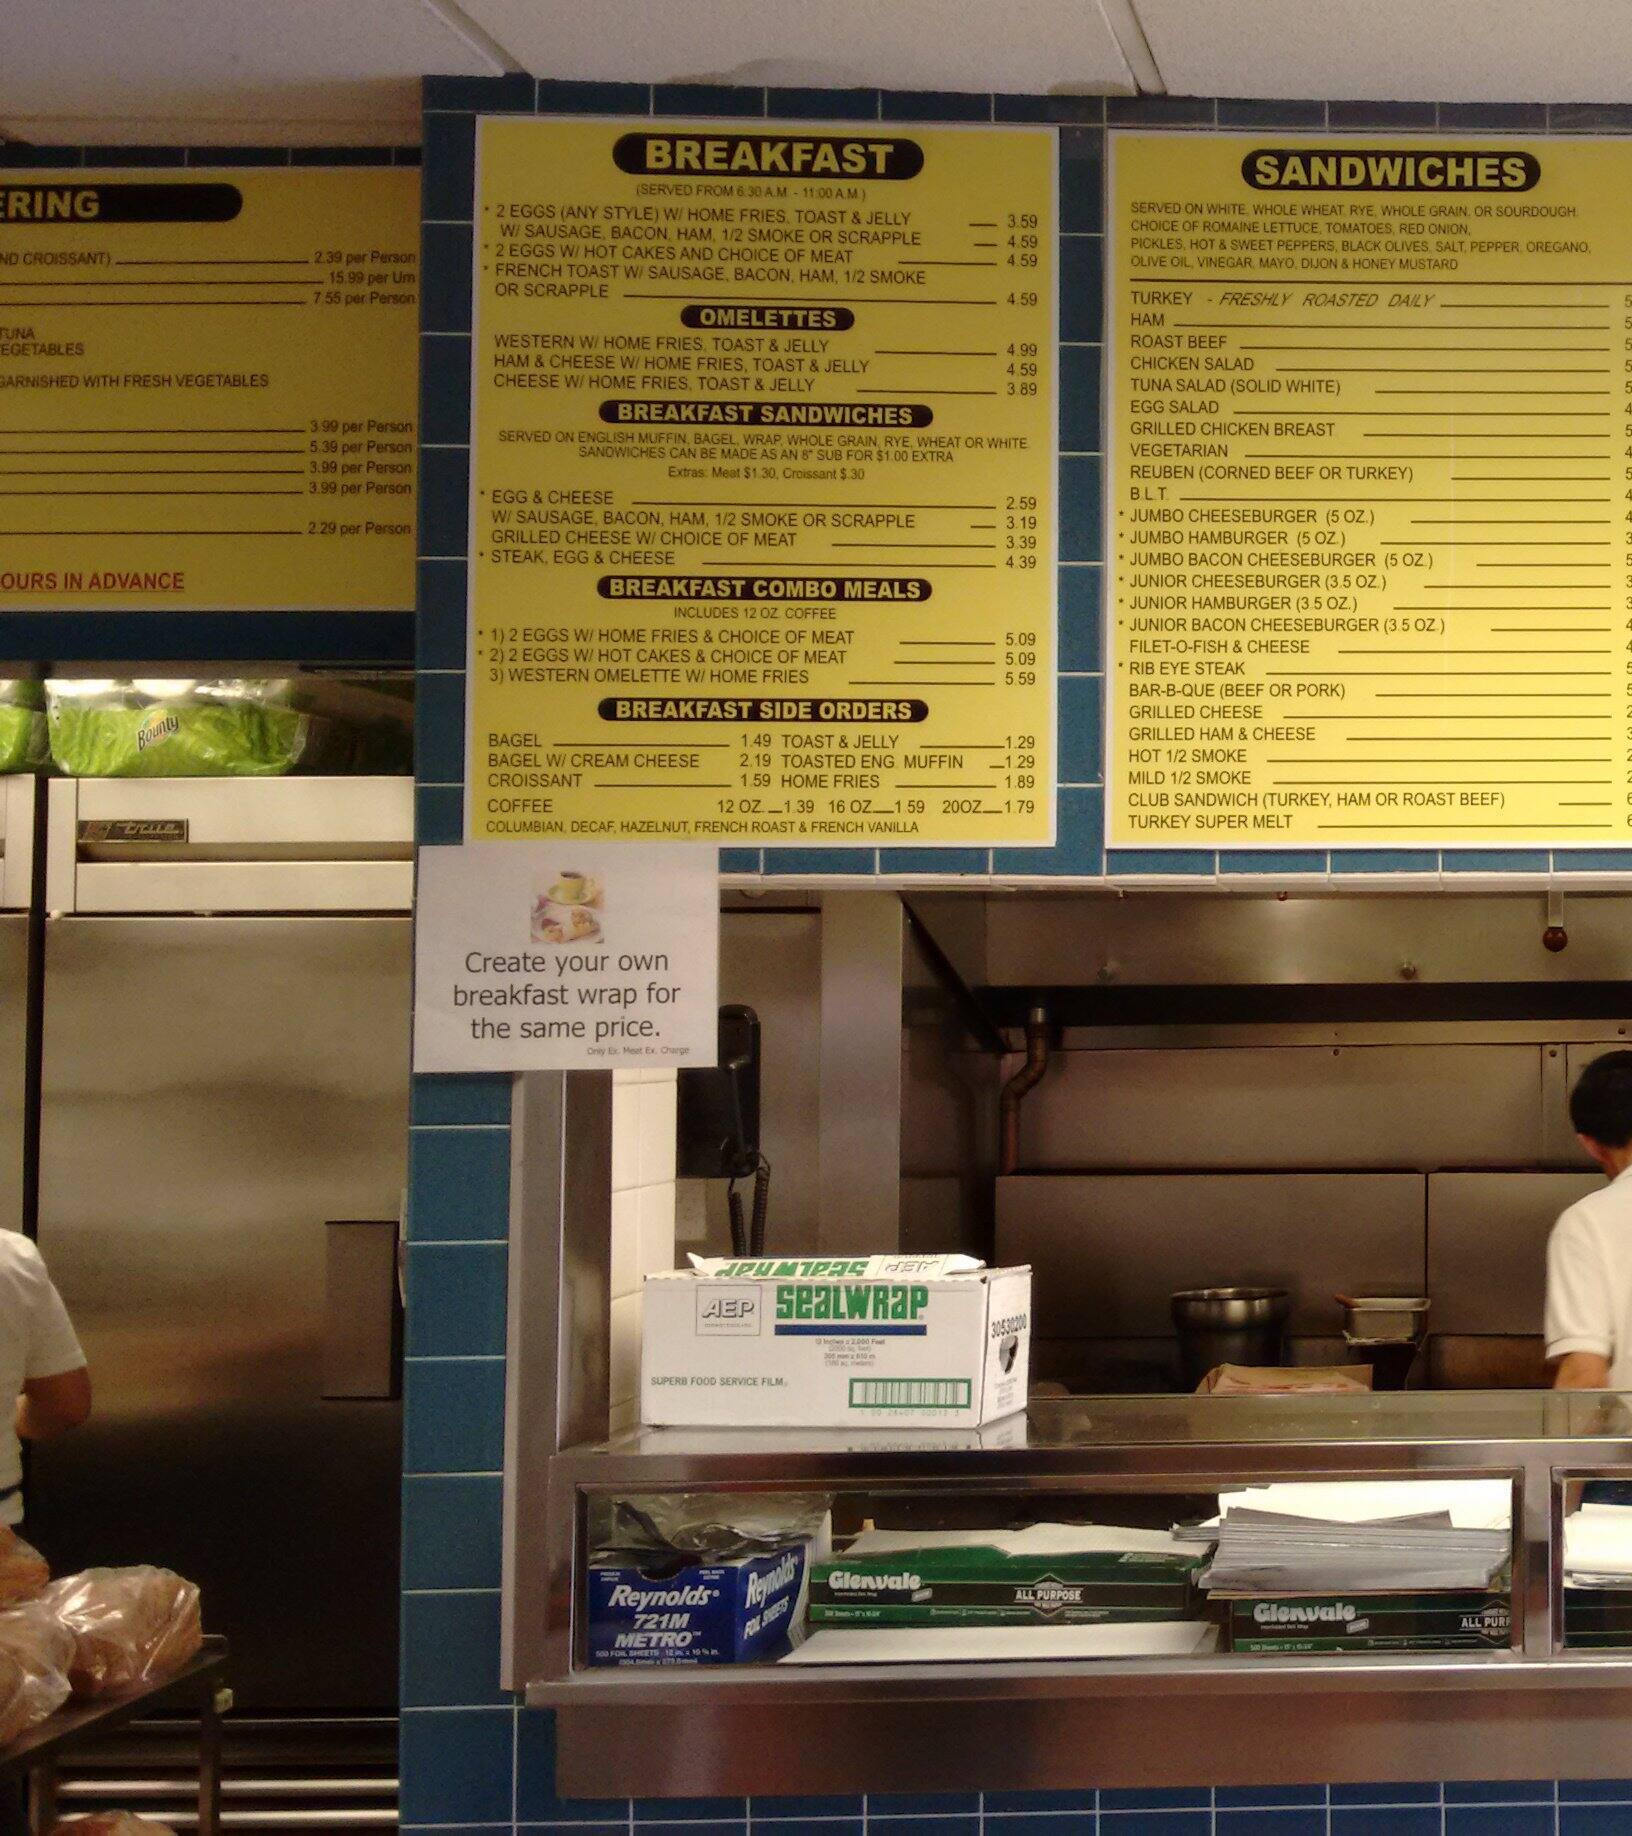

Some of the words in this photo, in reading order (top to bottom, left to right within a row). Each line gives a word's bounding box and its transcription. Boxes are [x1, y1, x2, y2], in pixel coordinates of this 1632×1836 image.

[646, 138, 894, 174] BREAKFAST
[1255, 156, 1527, 188] SANDWICHES
[0, 191, 100, 218] RING
[346, 253, 368, 266] per
[370, 249, 417, 264] Person
[699, 310, 836, 328] OMELETTES
[84, 375, 119, 388] WITH
[124, 375, 172, 388] FRESH
[176, 374, 269, 389] VEGETABLES
[619, 403, 753, 422] BREAKFAST
[761, 405, 912, 425] SANDWICHES
[1131, 442, 1227, 458] VEGETARIAN
[492, 489, 527, 504] EGG
[533, 490, 542, 505] &
[548, 490, 613, 505] CHEESE
[1007, 496, 1036, 511] 2.59
[1131, 508, 1183, 523] JUMBO
[1189, 508, 1316, 523] CHEESEBURGER
[1326, 509, 1339, 527] (5
[64, 572, 82, 590] IN
[89, 572, 184, 590] ADVANCE
[610, 579, 745, 597] BREAKFAST
[753, 579, 836, 598] COMBO
[845, 580, 920, 599] MEALS
[674, 607, 738, 619] INCLUDES
[744, 607, 756, 619] 12
[785, 607, 836, 620] COFFEE
[617, 700, 752, 719] BREAKFAST
[760, 701, 811, 719] SIDE
[820, 702, 911, 720] ORDERS
[138, 715, 180, 751] Bounty
[465, 951, 545, 973] Create
[555, 955, 609, 977] your
[619, 954, 668, 971] own
[454, 983, 568, 1007] breakfast
[578, 988, 637, 1010] wrap
[647, 982, 680, 1004] for
[471, 1017, 510, 1039] the
[520, 1020, 585, 1039] same
[596, 1015, 659, 1042] price.
[702, 1299, 754, 1319] AEP
[651, 1377, 687, 1386] SUPERB
[691, 1376, 716, 1386] FOOD
[720, 1377, 758, 1387] SERVICE
[761, 1377, 783, 1387] FILM
[745, 1554, 796, 1609] Reynolds
[828, 1570, 921, 1590] Glenvale
[608, 1585, 712, 1612] Reynolds
[1015, 1590, 1033, 1602] ALL
[1035, 1589, 1081, 1602] PURPOSE
[633, 1613, 690, 1630] 721M
[1253, 1602, 1356, 1623] Glenvale
[1461, 1617, 1482, 1628] ALL
[615, 1632, 694, 1648] METRO
